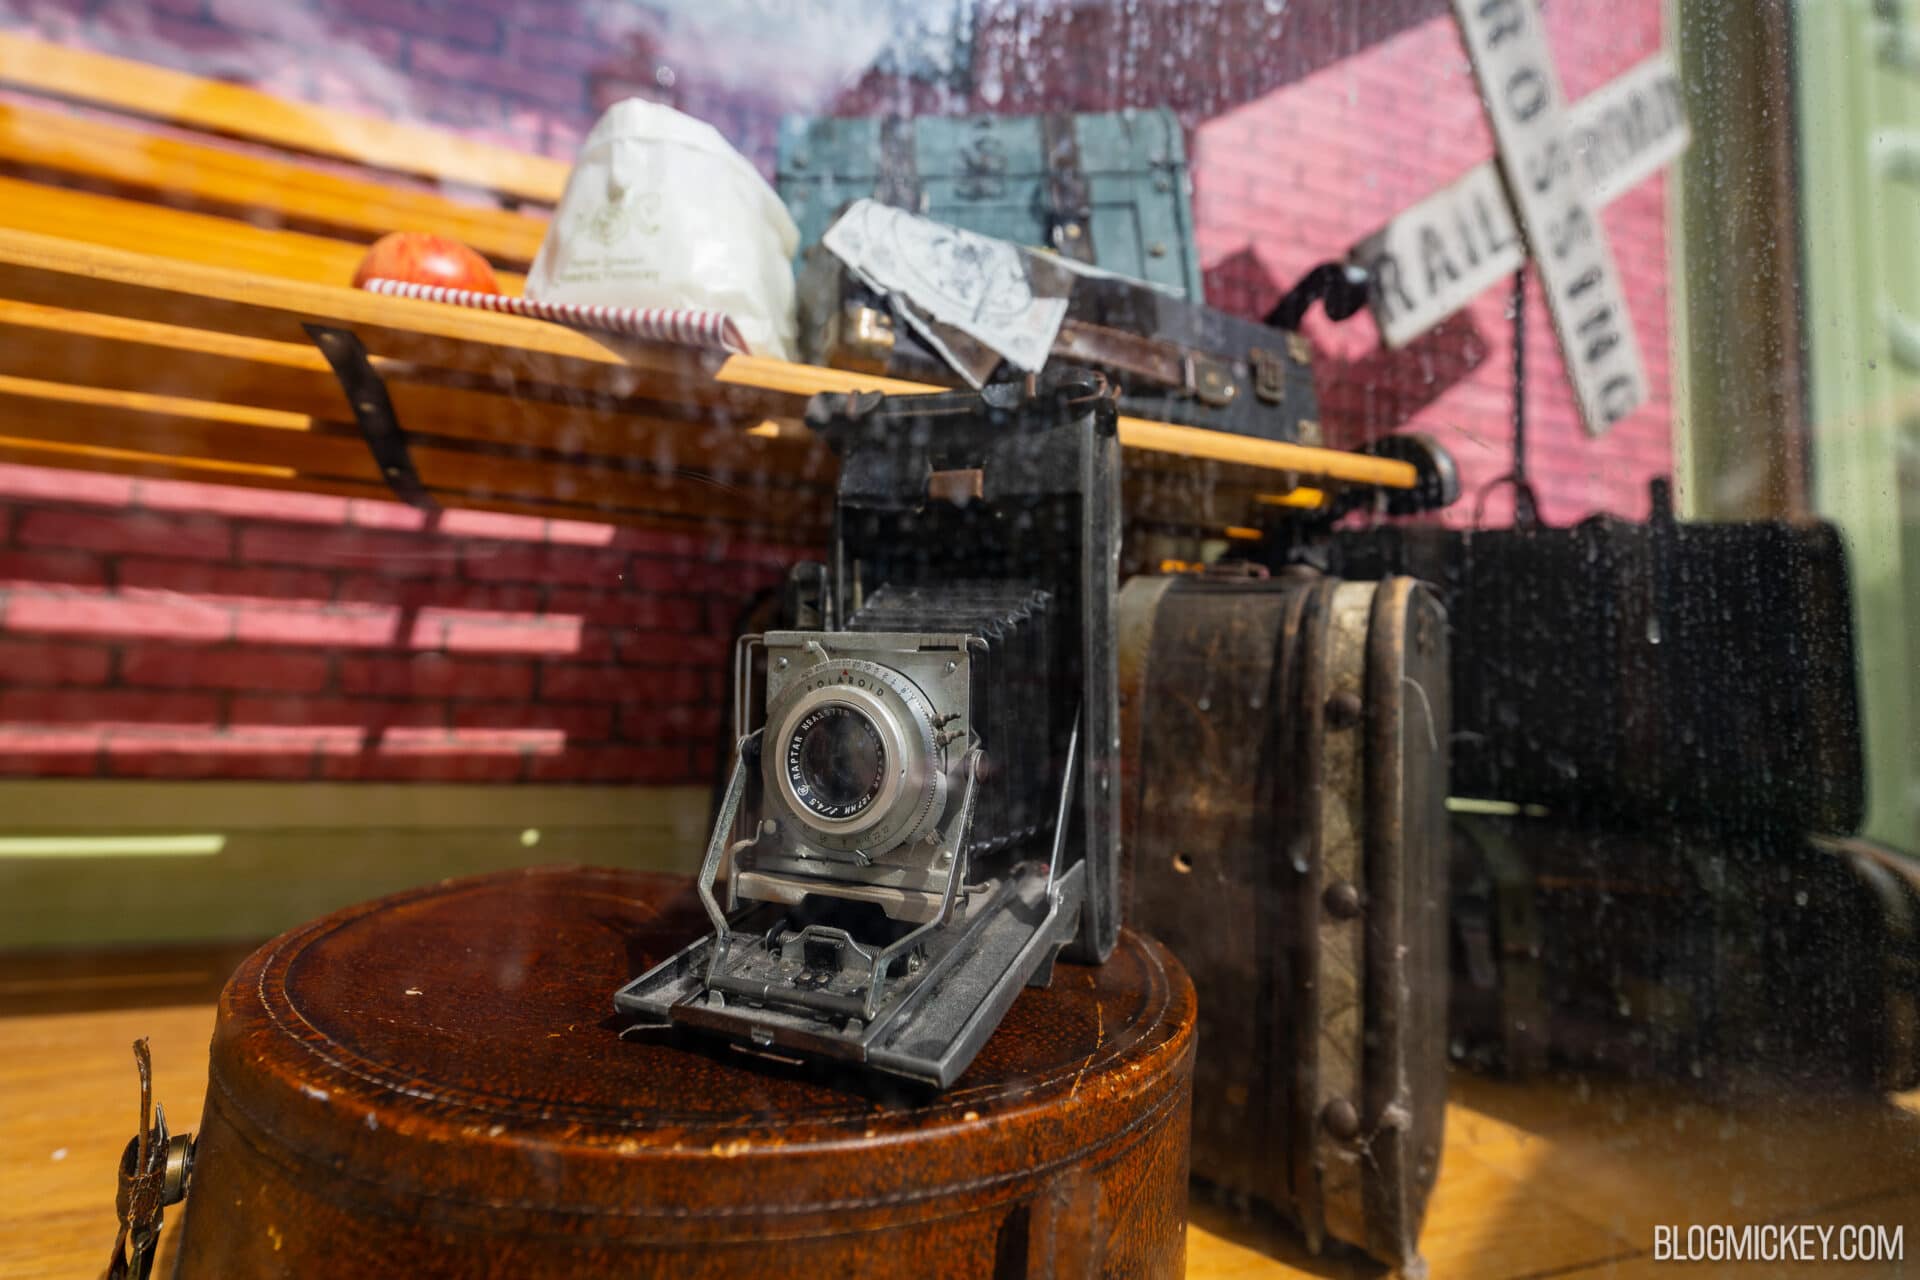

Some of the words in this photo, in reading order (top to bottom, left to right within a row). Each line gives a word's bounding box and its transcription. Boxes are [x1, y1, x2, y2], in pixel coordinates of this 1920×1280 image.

[1370, 192, 1520, 324] RAIL
[807, 676, 884, 697] POLAROID
[790, 735, 804, 780] RAPTAR
